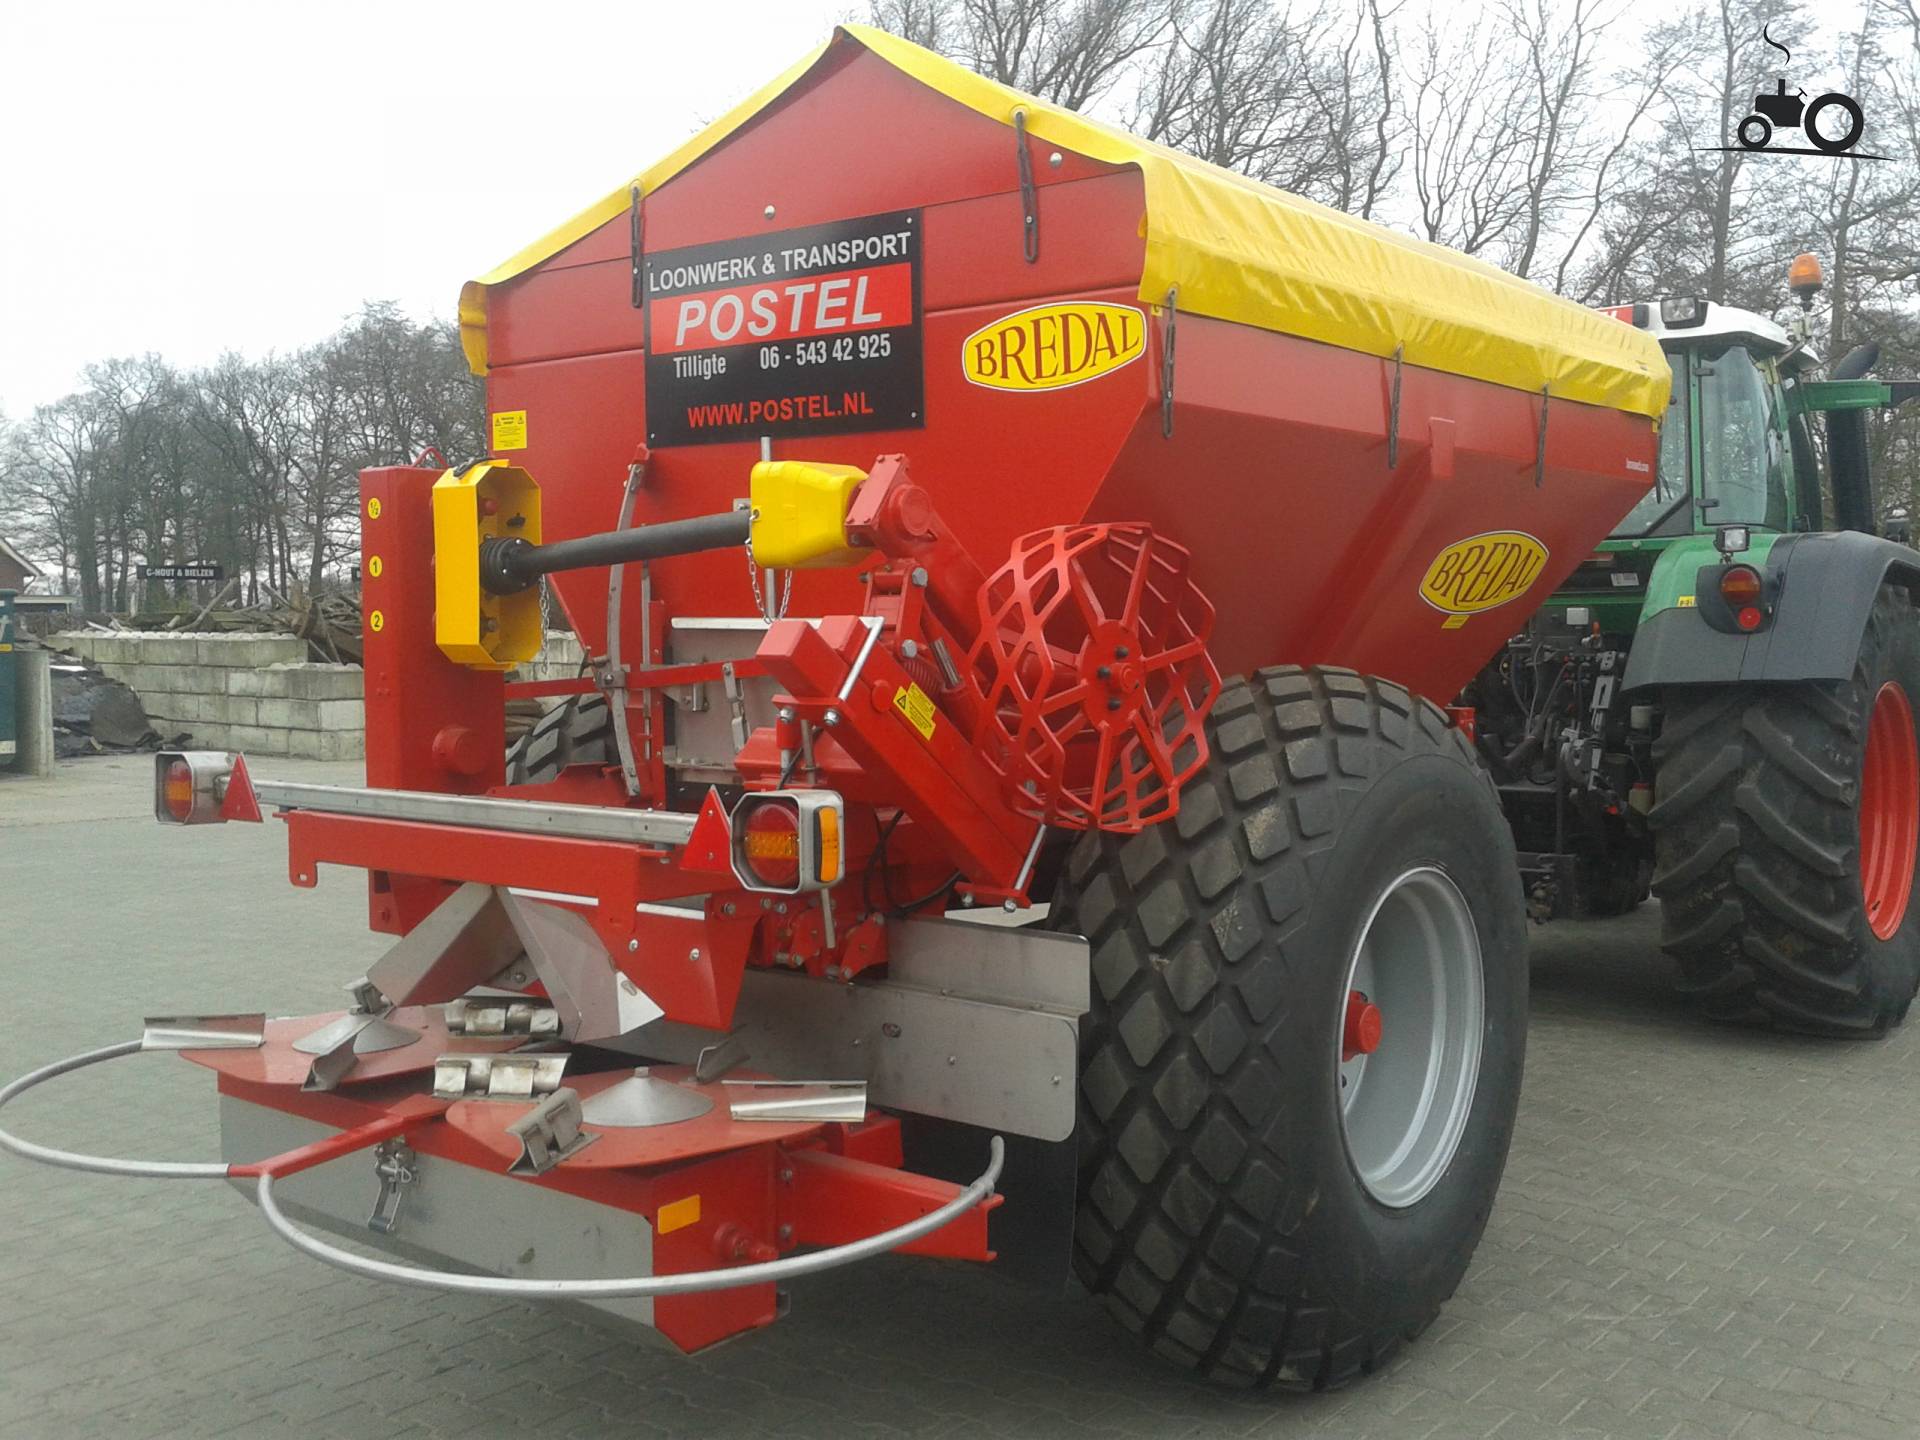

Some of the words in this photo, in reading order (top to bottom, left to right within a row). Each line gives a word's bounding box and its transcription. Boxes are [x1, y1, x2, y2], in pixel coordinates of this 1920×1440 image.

[649, 256, 757, 293] LOONWERK
[762, 253, 776, 275] &
[781, 231, 911, 272] TRANSPORT
[675, 275, 882, 347] POSTEL
[673, 353, 727, 380] Tilligte
[759, 346, 780, 370] 06
[796, 340, 827, 366] 543
[832, 337, 854, 361] 42
[858, 333, 891, 358] 925
[975, 312, 1139, 384] BREDAL
[687, 391, 873, 428] WWW.POSTEL.NL
[1429, 542, 1540, 606] BREDAL
